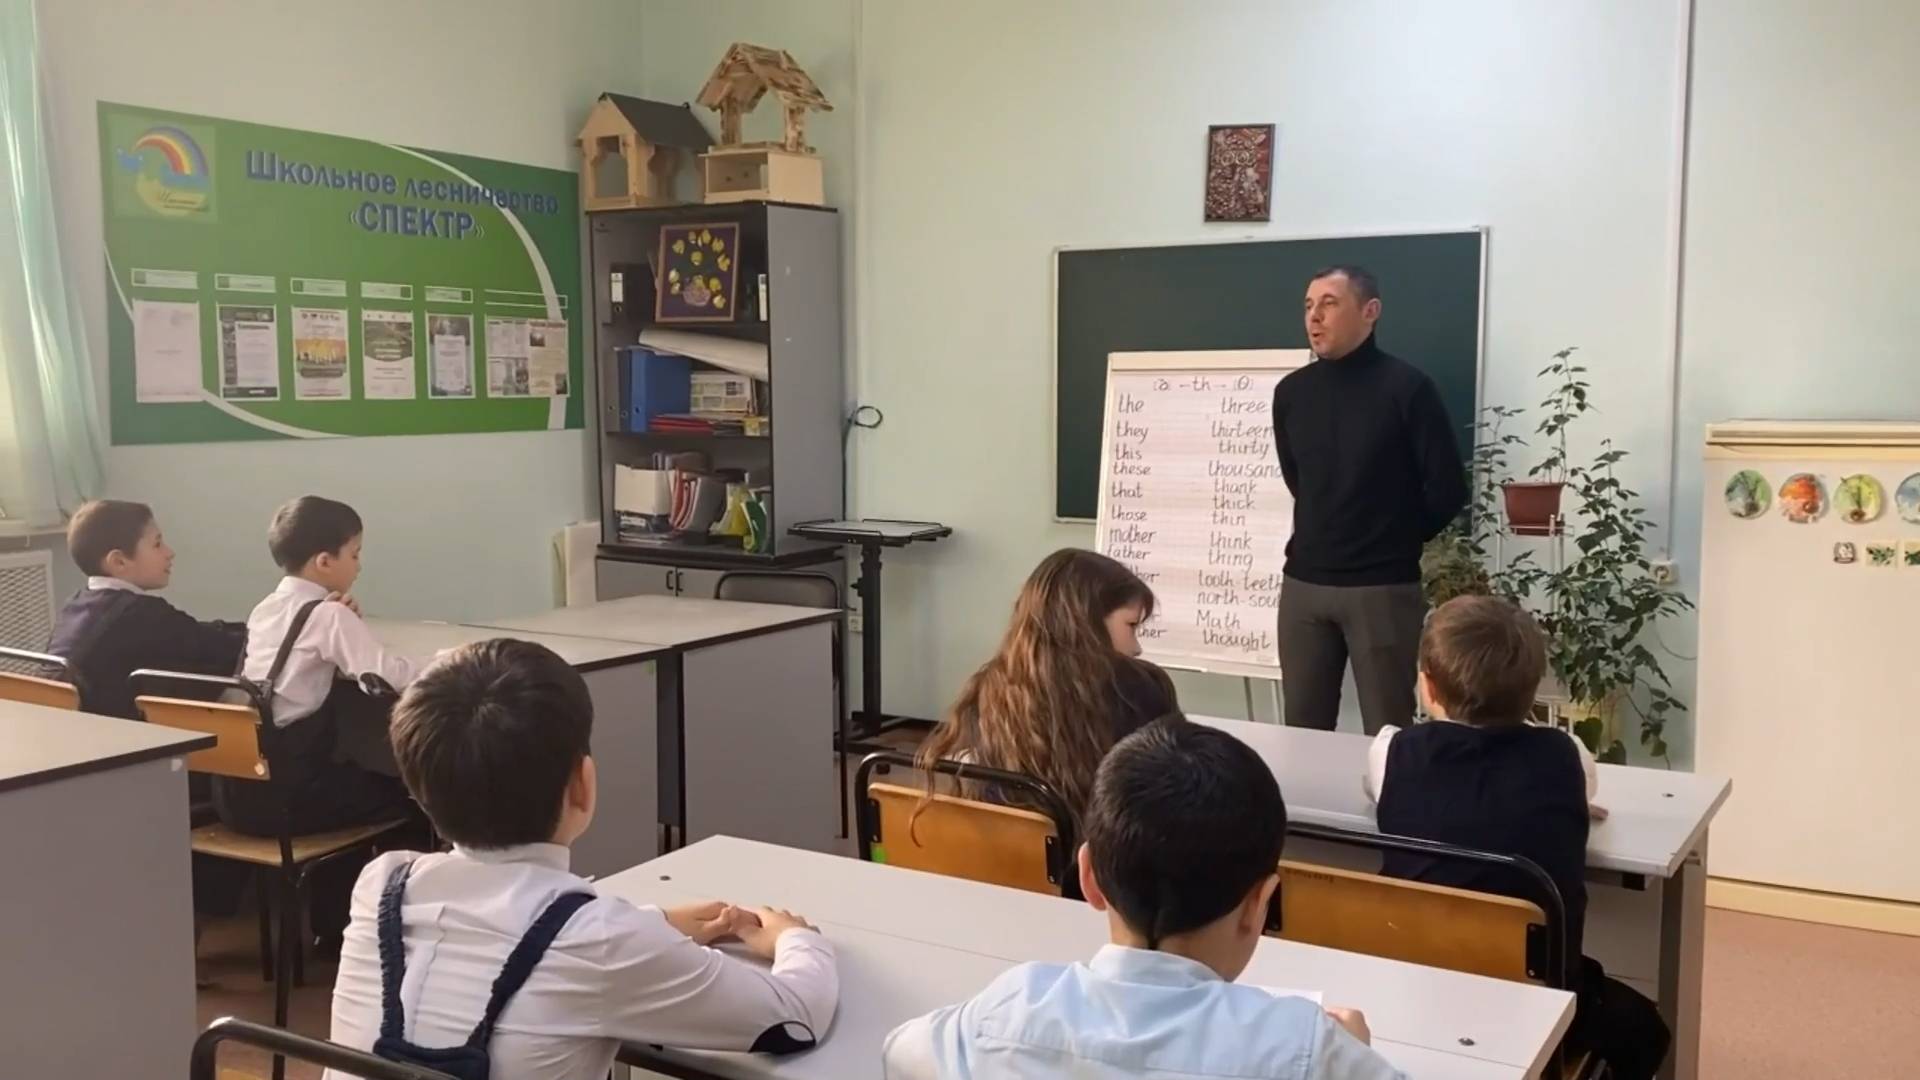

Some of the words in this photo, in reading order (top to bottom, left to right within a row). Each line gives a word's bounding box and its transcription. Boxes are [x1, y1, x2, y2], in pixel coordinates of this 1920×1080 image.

[246, 149, 396, 195] Школьное
[403, 178, 560, 215] лесничество
[349, 201, 486, 240] «СПЕКТР»
[1118, 393, 1145, 413] the
[1221, 397, 1269, 413] three
[1116, 420, 1149, 444] they
[1114, 443, 1142, 460] this
[1219, 440, 1270, 460] thirty
[1113, 461, 1152, 475] these
[1111, 482, 1143, 498] that
[1213, 478, 1257, 494] thank
[1212, 494, 1255, 510] thick
[1111, 504, 1148, 521] those
[1211, 511, 1246, 526] thin
[1108, 524, 1157, 543] mother
[1209, 531, 1253, 549] think
[1207, 548, 1254, 571] thing
[1196, 609, 1241, 630] Math
[1202, 629, 1271, 652] thought
